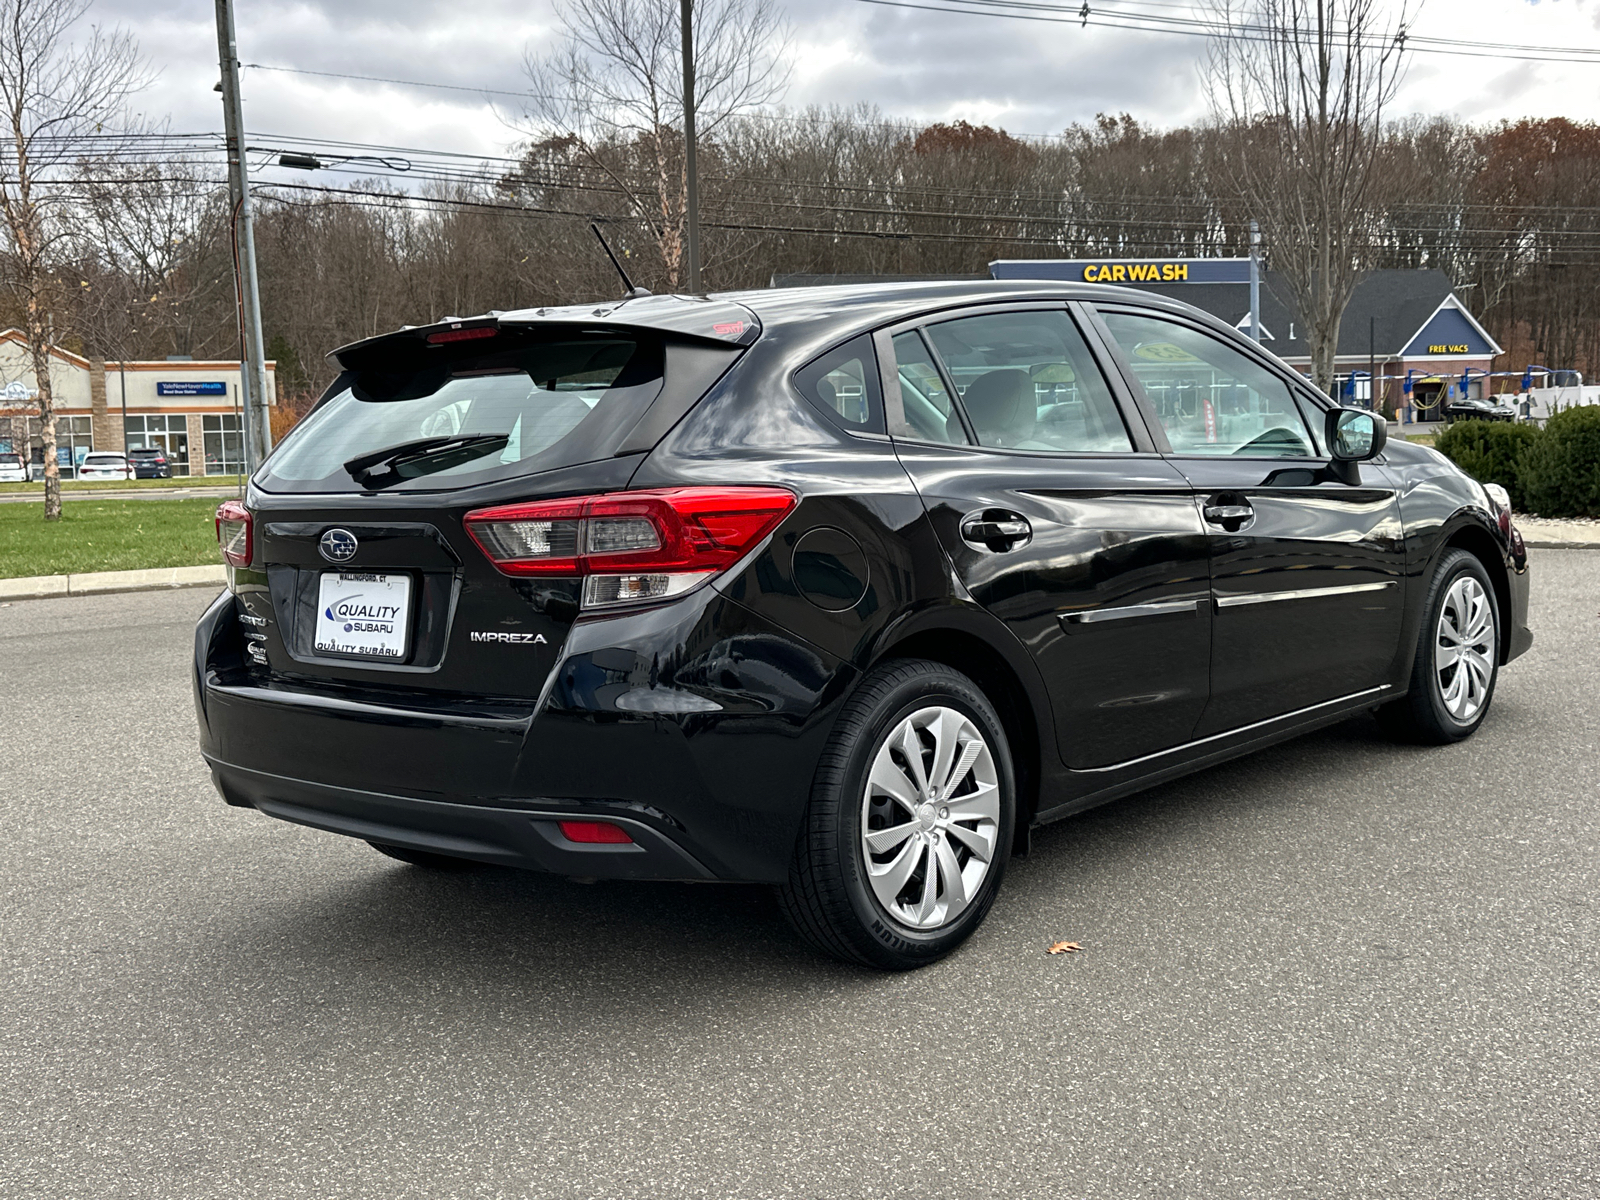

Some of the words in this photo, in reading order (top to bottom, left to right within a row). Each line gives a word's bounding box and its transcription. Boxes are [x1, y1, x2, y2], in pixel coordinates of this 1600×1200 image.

[1429, 345, 1447, 353] FREE
[1448, 344, 1469, 353] VACS
[379, 575, 387, 583] CT
[338, 604, 400, 619] QUALITY
[353, 622, 394, 634] SUBARU
[470, 631, 548, 644] IMPREZA
[317, 642, 356, 653] QUALITY
[358, 646, 398, 656] SUBARU
[870, 919, 928, 954] SAILUN
